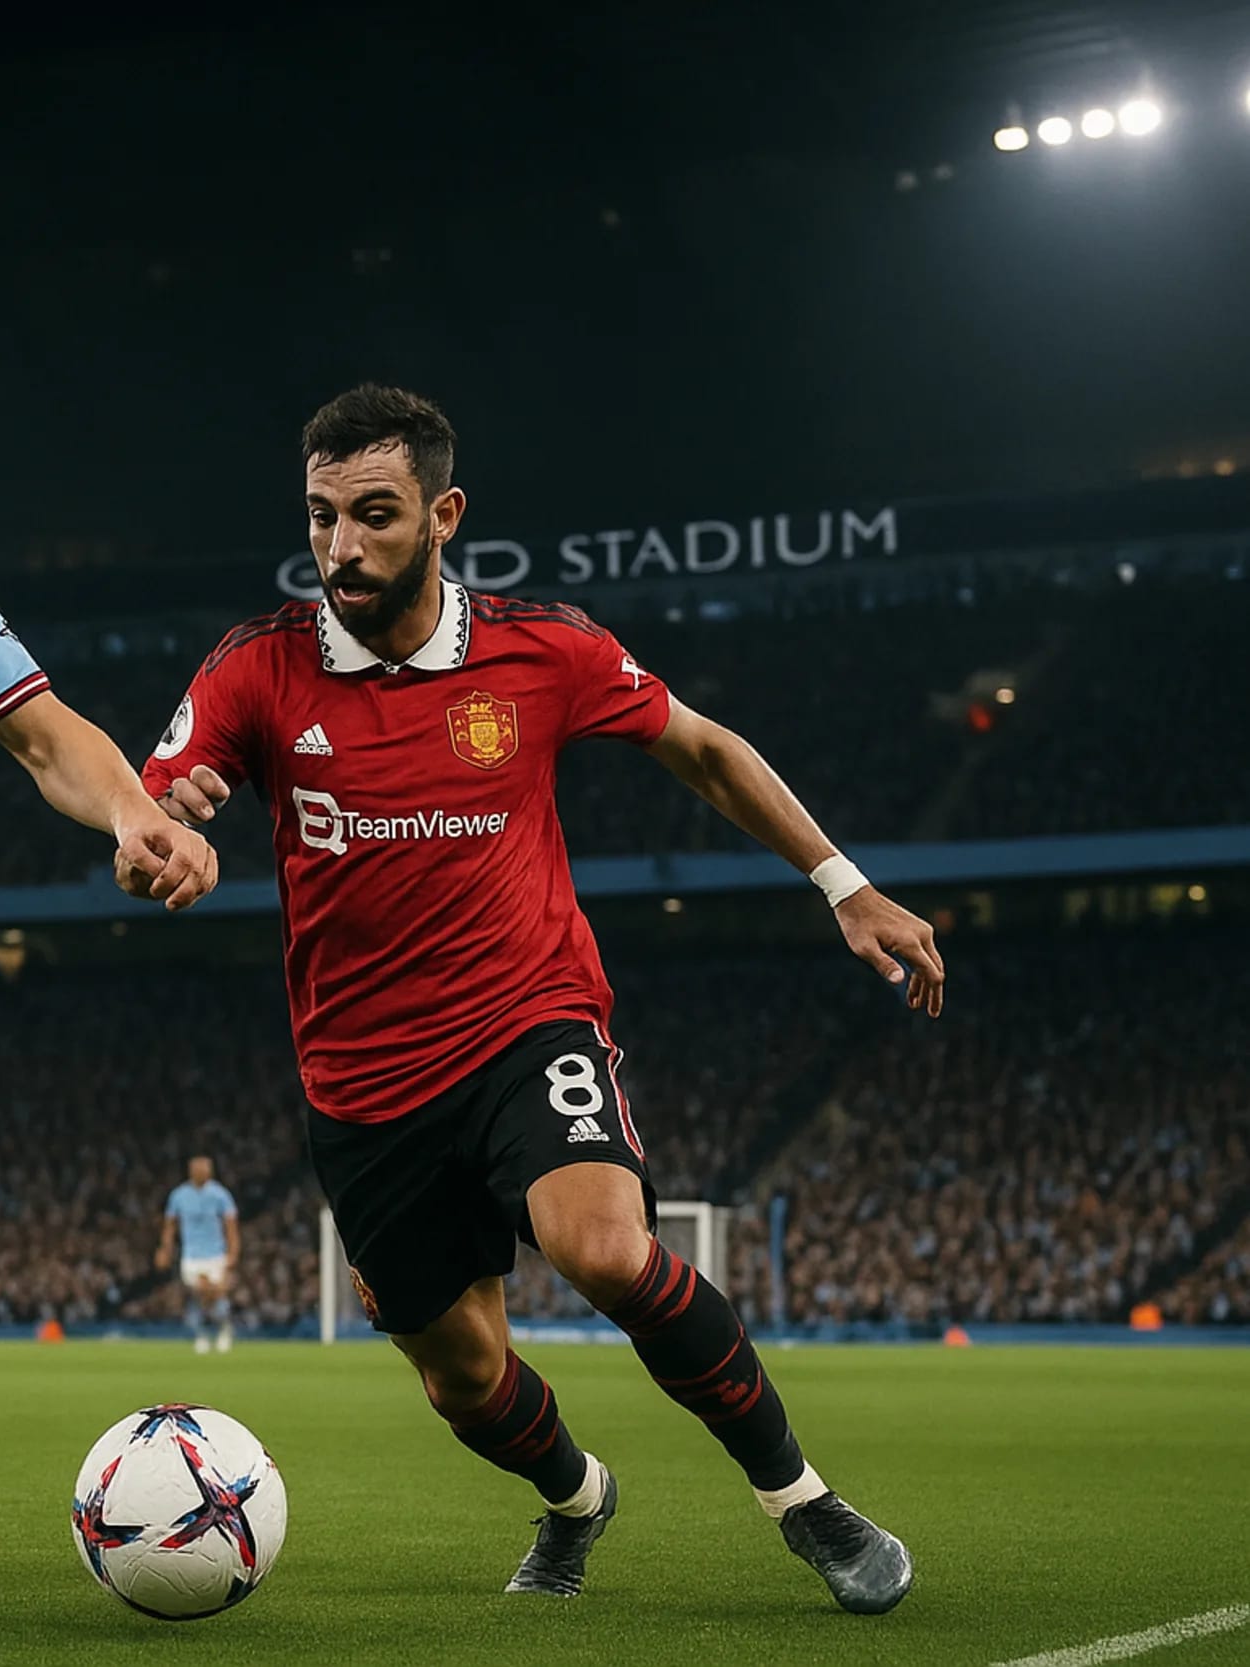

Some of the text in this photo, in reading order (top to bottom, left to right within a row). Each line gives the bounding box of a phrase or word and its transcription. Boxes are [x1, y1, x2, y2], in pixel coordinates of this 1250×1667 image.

[558, 506, 898, 585] STADIUM
[341, 809, 510, 840] TeamViewer
[544, 1052, 604, 1117] 8
